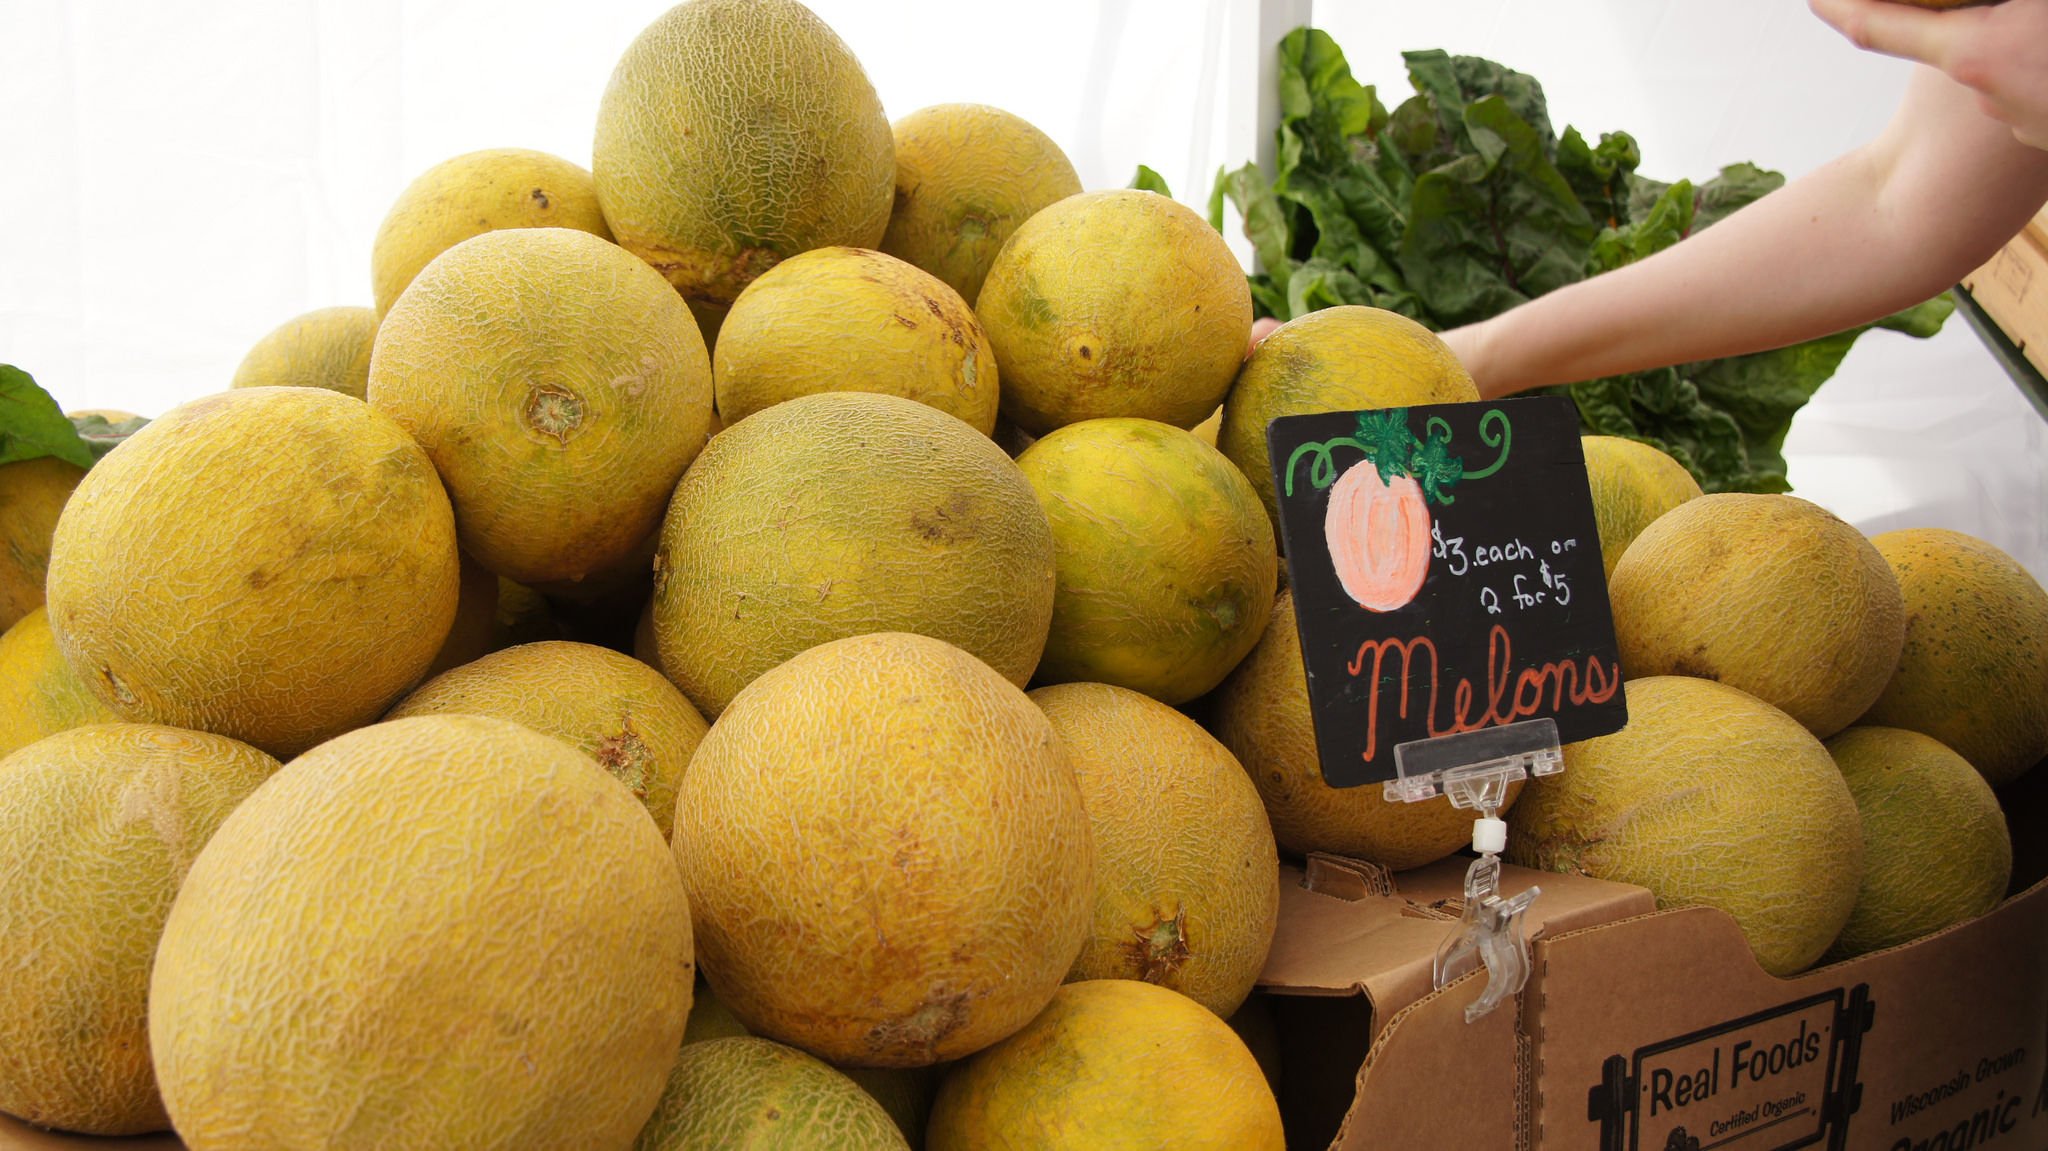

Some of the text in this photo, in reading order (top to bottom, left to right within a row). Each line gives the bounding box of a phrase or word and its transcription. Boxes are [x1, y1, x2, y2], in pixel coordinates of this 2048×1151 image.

[1551, 538, 1577, 555] or
[1480, 558, 1571, 614] 2 for $5
[1347, 623, 1619, 762] Melons
[1650, 1019, 1820, 1117] Real Foods
[1891, 1047, 2025, 1126] Wisconsin Grown
[1710, 1091, 1806, 1137] Certified Organic
